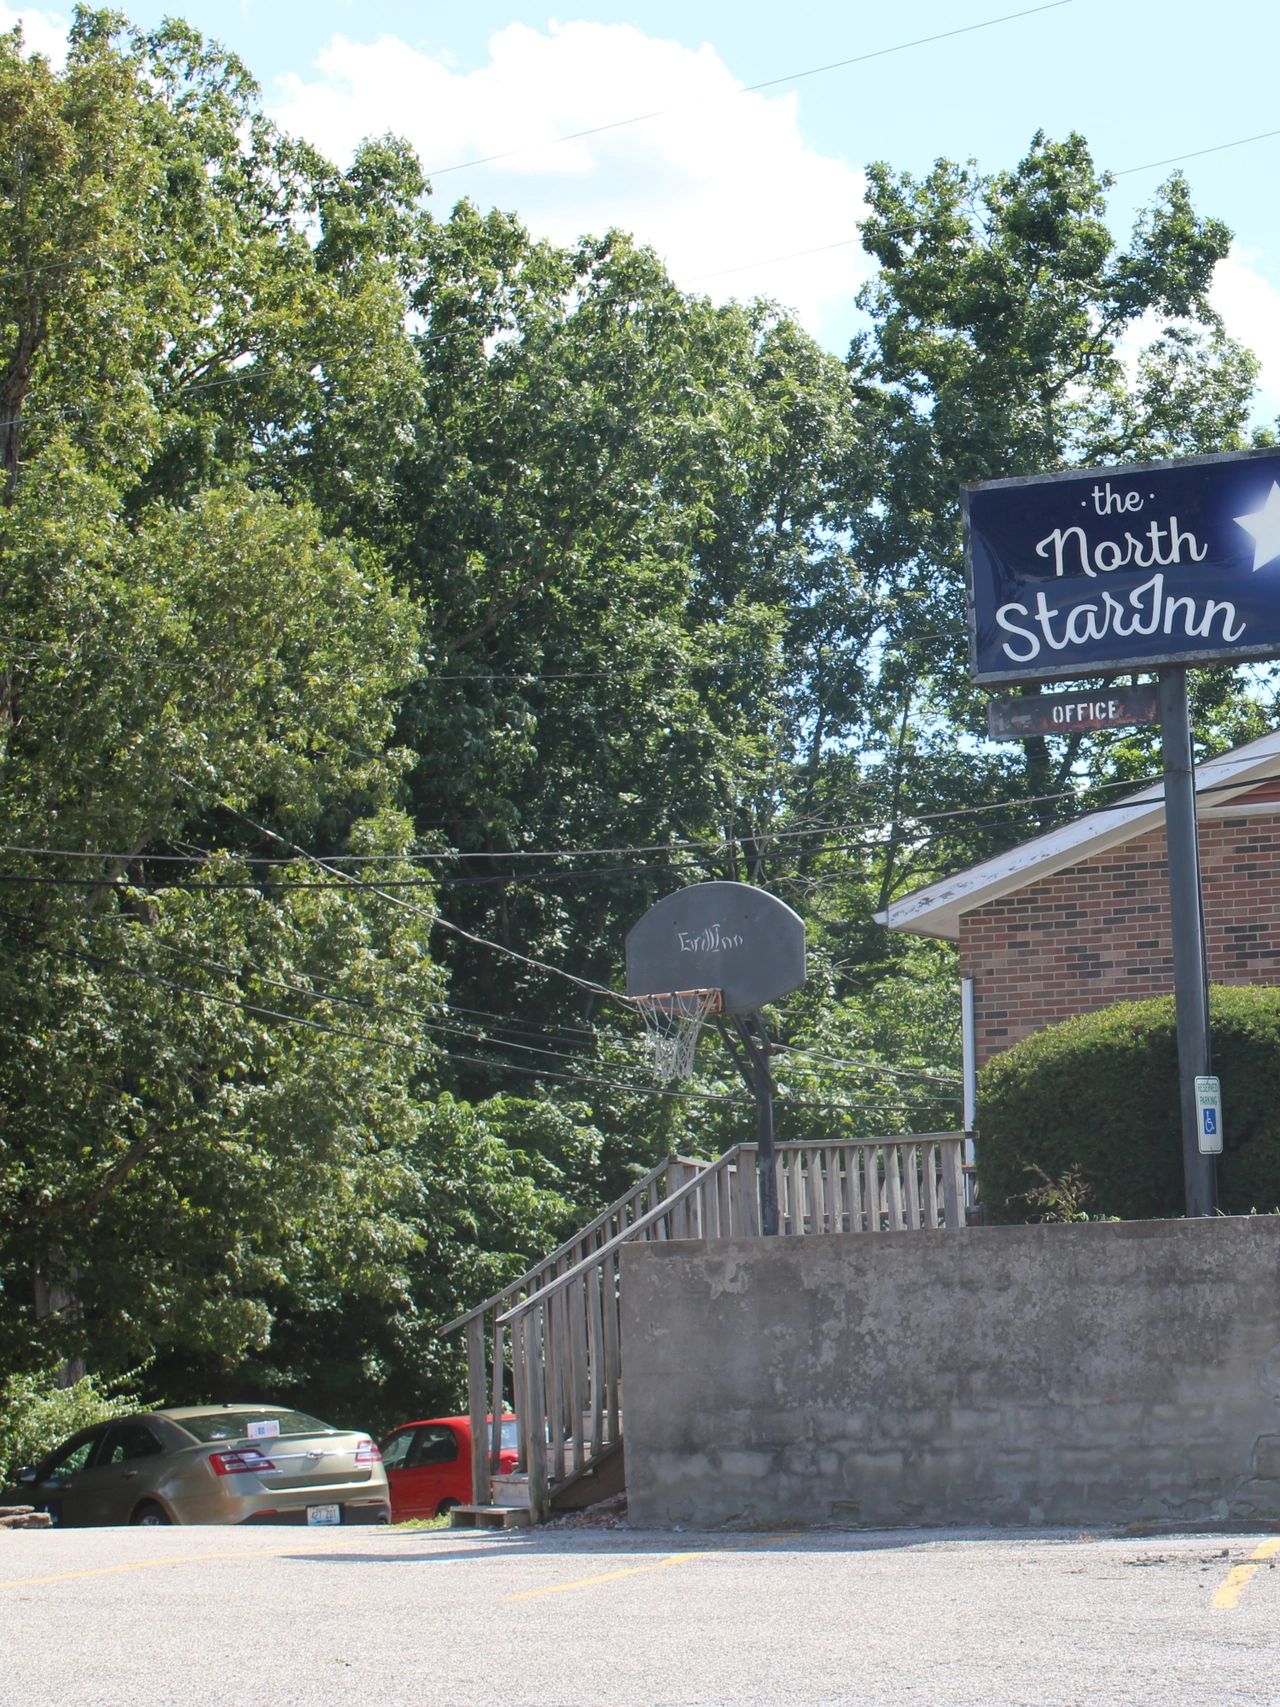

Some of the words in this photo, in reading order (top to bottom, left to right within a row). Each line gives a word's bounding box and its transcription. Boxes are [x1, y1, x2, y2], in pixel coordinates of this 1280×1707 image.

[1091, 482, 1145, 516] the
[1035, 516, 1209, 579] North
[1052, 700, 1118, 724] OFFICE
[1199, 1096, 1218, 1105] PARKING
